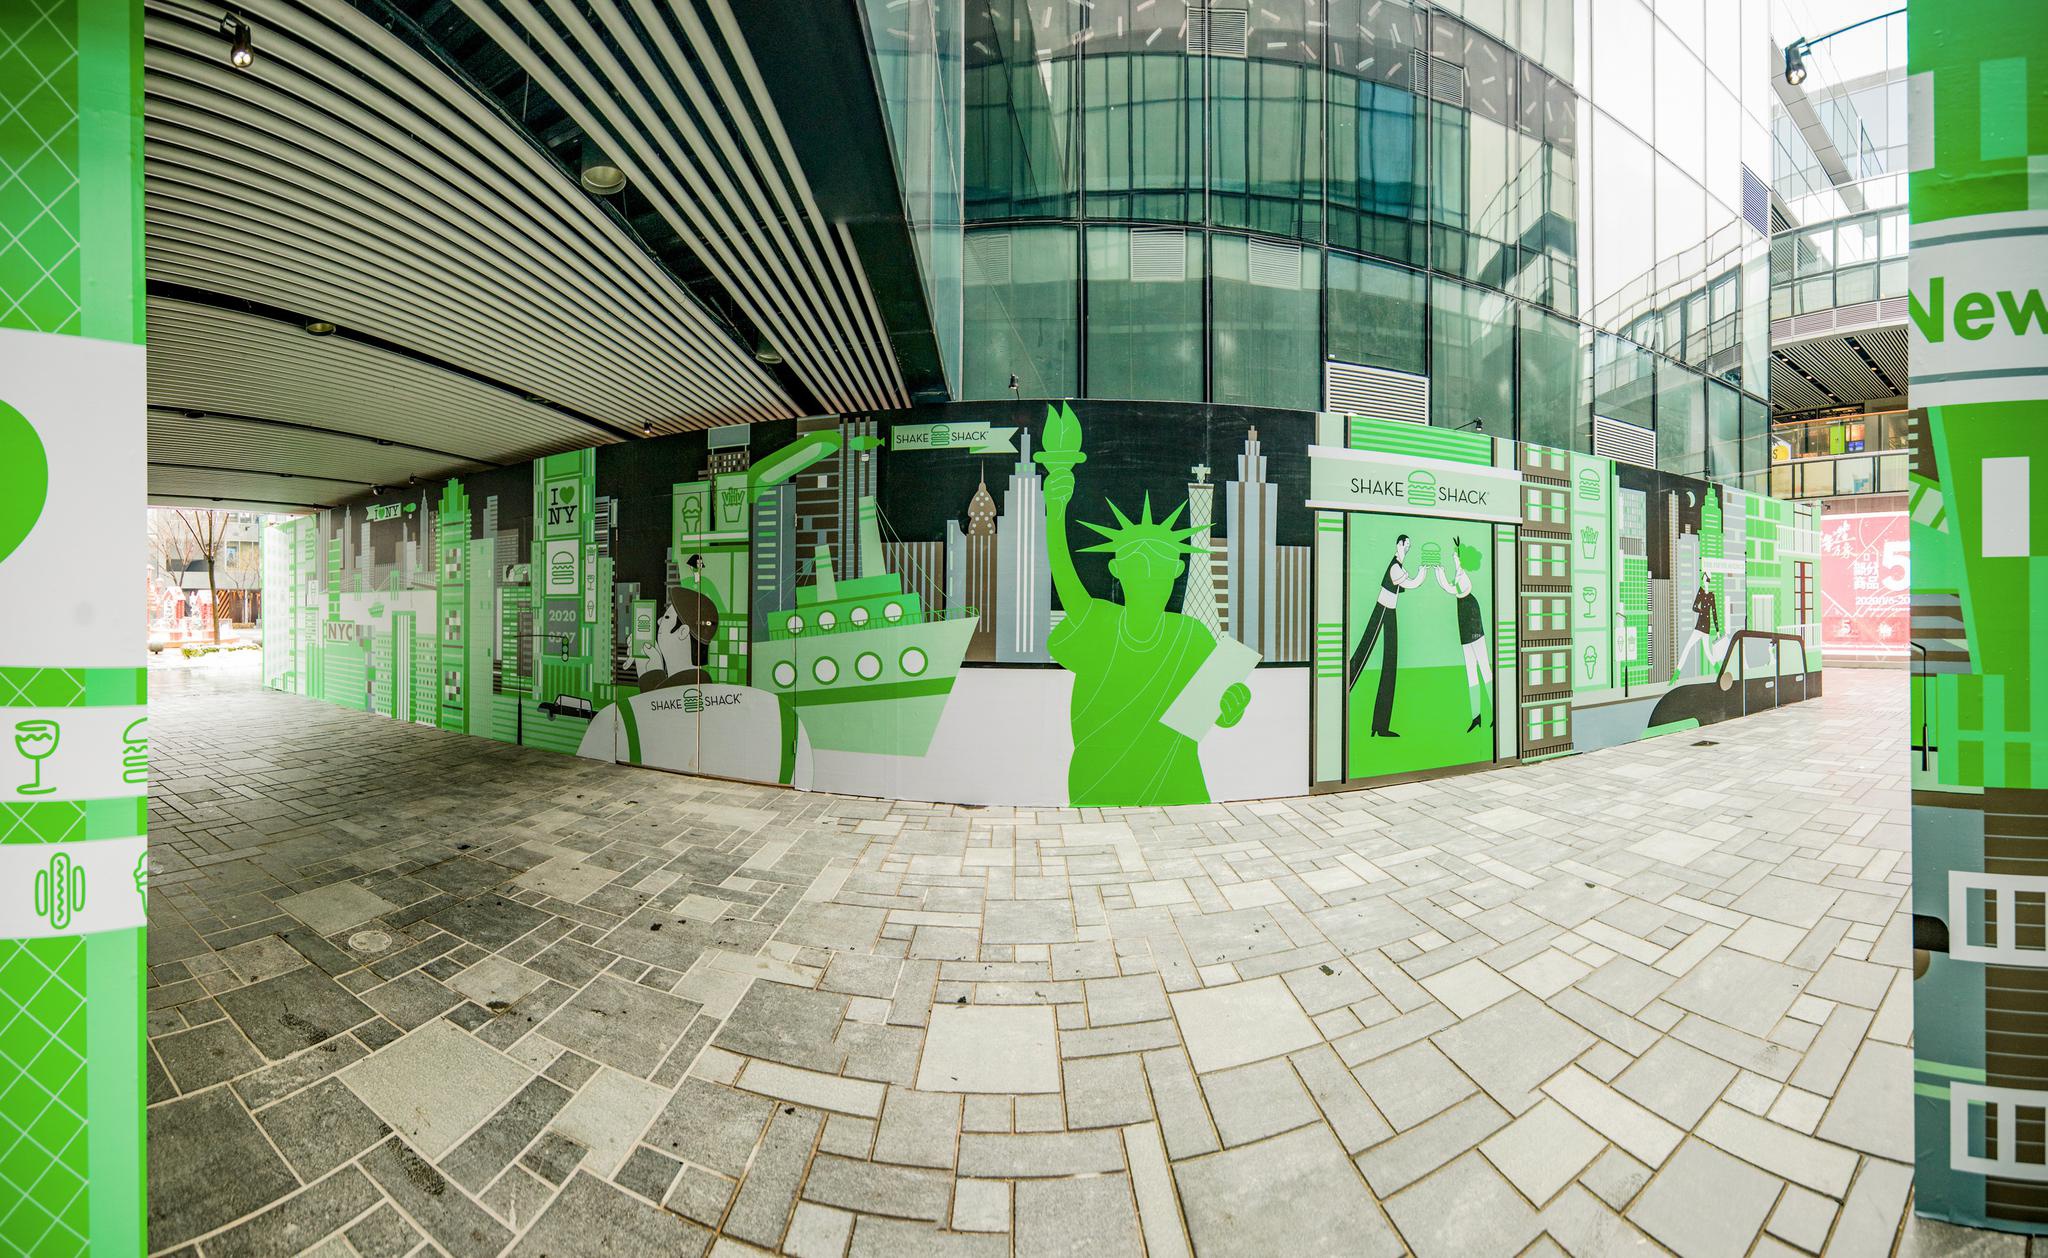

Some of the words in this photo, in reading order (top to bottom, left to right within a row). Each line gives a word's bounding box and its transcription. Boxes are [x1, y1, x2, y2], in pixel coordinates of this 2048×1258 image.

[1908, 276, 2048, 343] New
[896, 433, 929, 444] SHAKE
[951, 431, 988, 441] SHACK
[551, 487, 558, 506] I
[1350, 477, 1404, 497] SHAKE
[1438, 486, 1488, 505] SHACK
[385, 505, 399, 518] NY
[548, 505, 577, 525] NY
[1882, 540, 1910, 592] 5
[549, 610, 576, 621] 2020
[328, 623, 353, 641] NYC
[651, 699, 682, 711] SHAKE
[705, 693, 742, 707] SHACK
